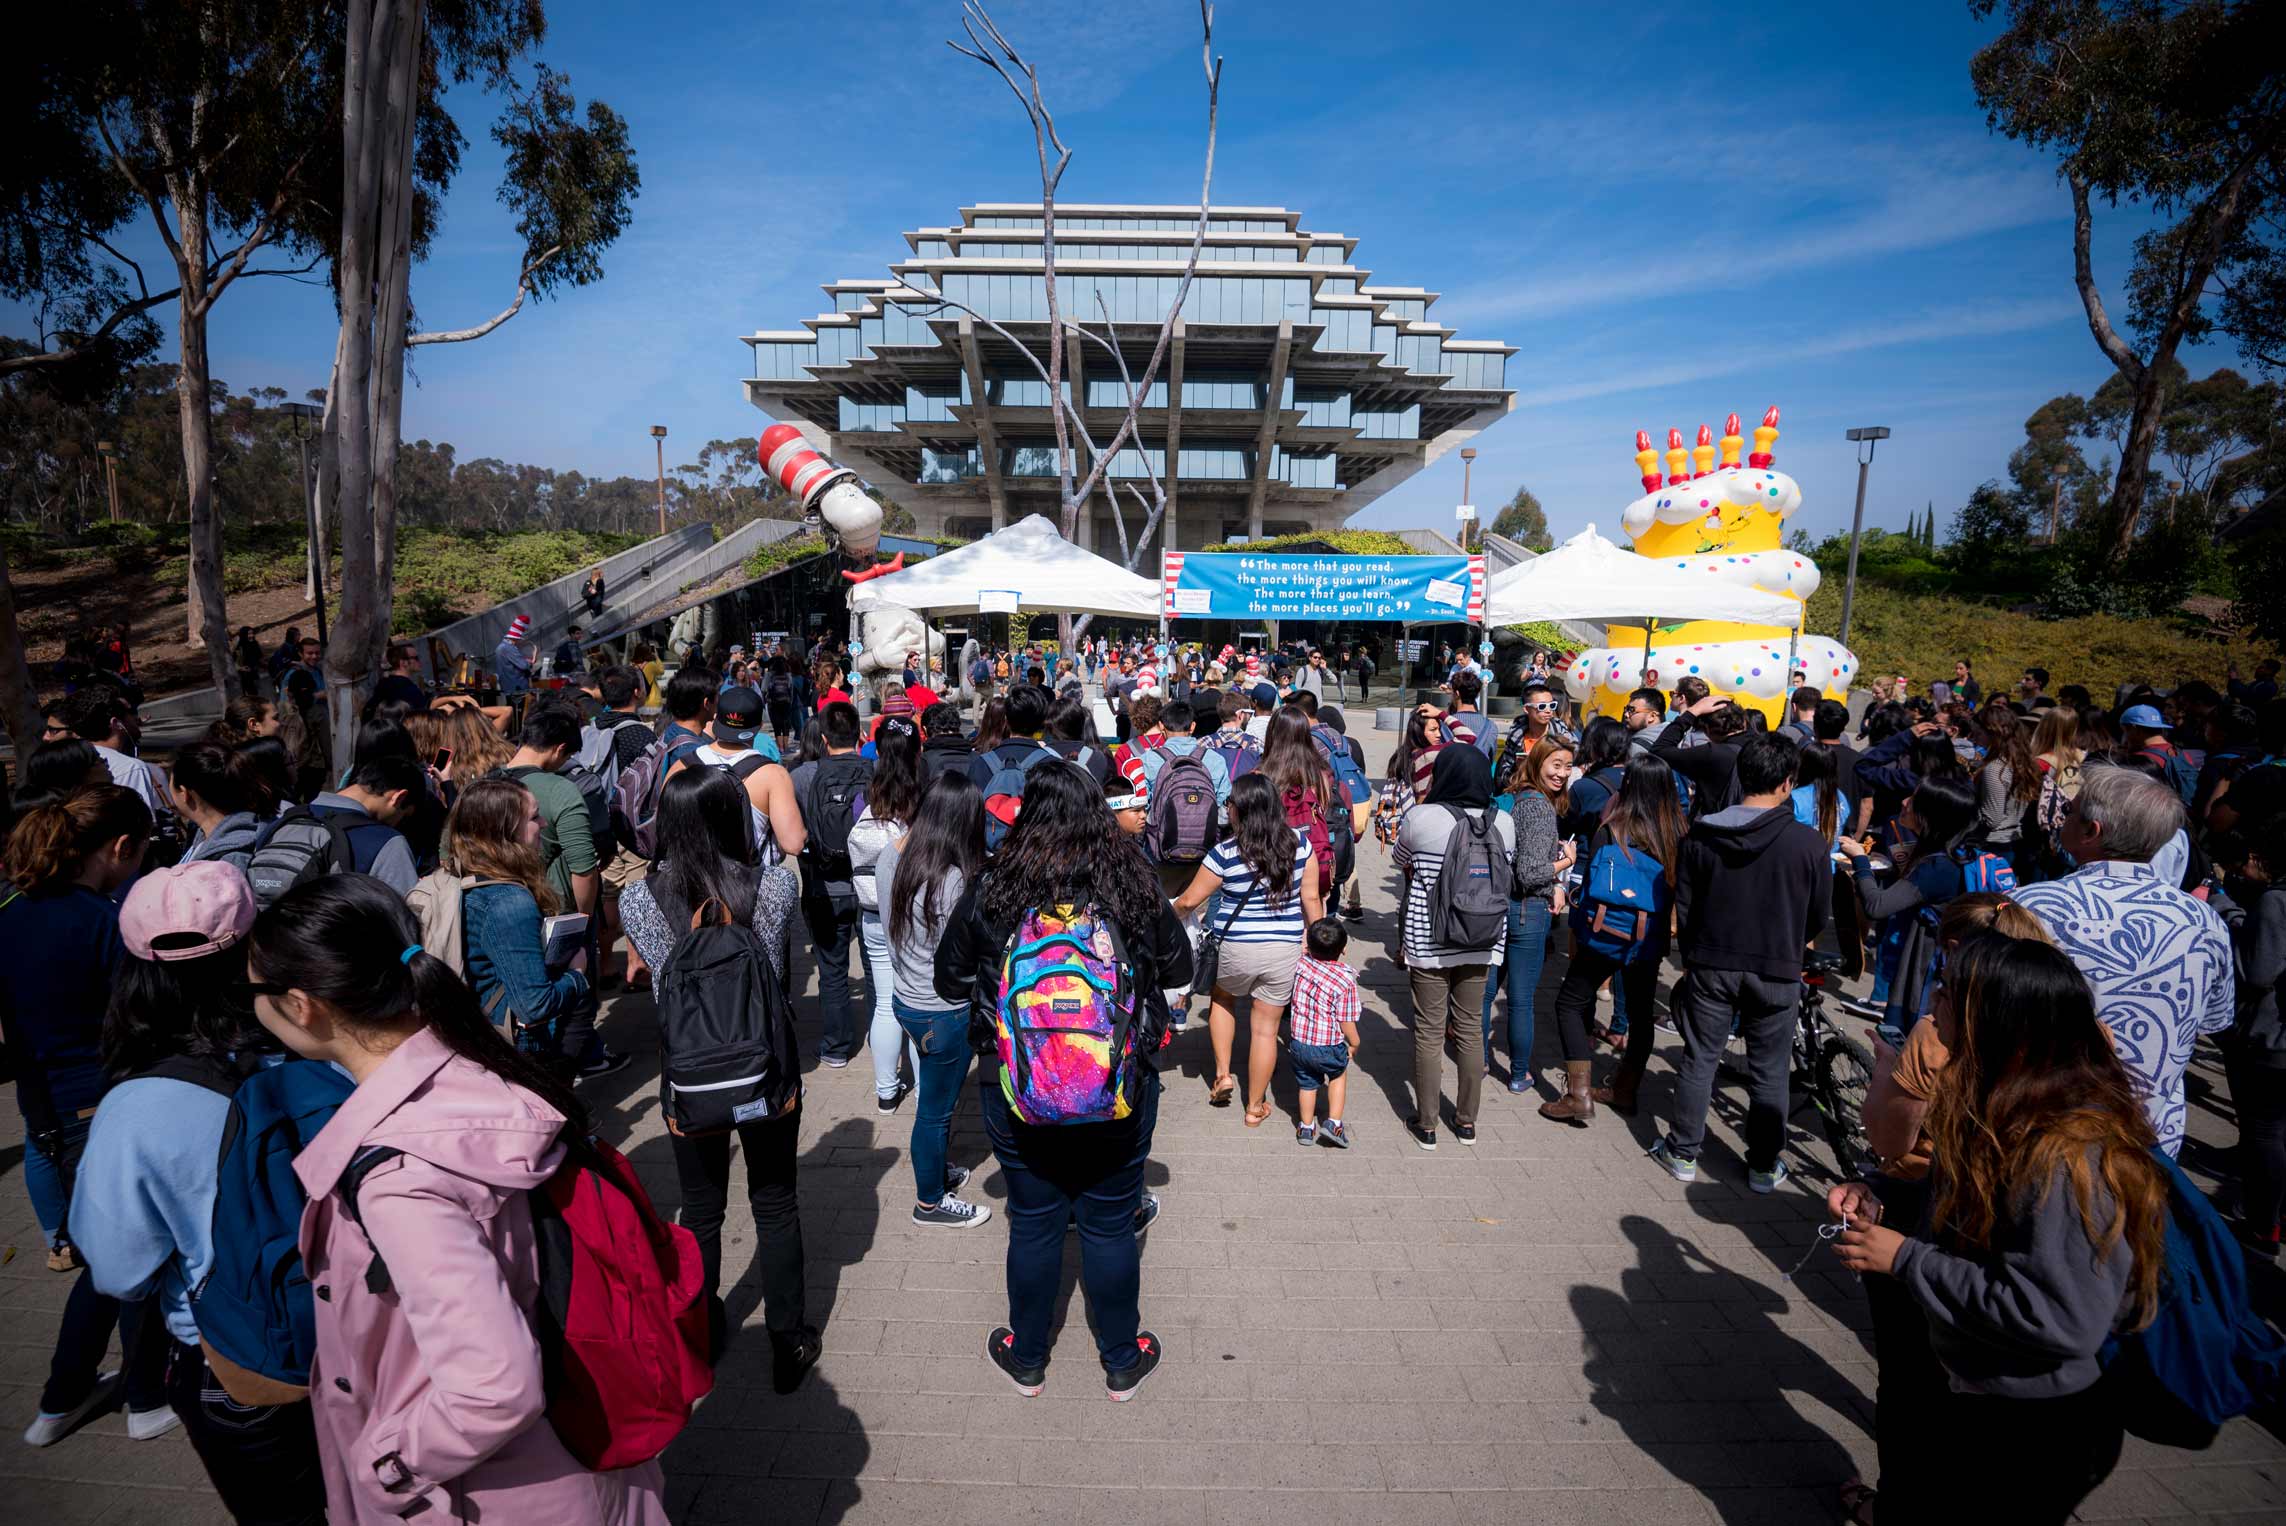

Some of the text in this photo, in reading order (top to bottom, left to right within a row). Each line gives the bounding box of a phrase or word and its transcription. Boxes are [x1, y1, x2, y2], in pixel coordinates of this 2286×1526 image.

[1282, 562, 1309, 570] more
[1313, 560, 1337, 571] that
[1342, 563, 1361, 574] you
[1237, 572, 1412, 588] the more things you will know.
[1254, 586, 1274, 598] The
[1311, 587, 1334, 599] that
[1339, 591, 1358, 601] you
[1249, 601, 1267, 612] the
[1272, 604, 1298, 612] more
[1303, 602, 1338, 615] places
[1342, 601, 1373, 615] you'll
